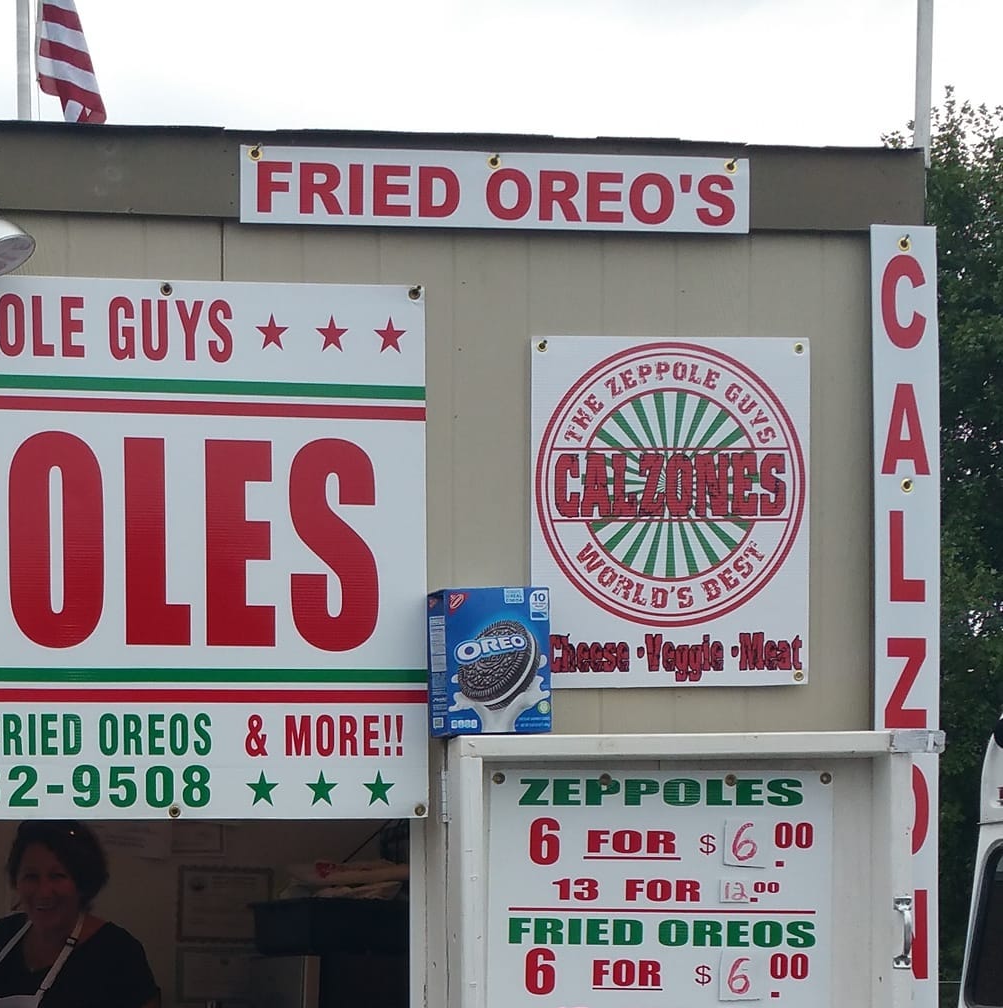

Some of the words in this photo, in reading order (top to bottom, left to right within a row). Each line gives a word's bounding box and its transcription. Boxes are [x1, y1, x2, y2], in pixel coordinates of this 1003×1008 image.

[256, 160, 461, 218] FRIED
[485, 168, 737, 227] OREO'S
[108, 295, 233, 363] GUYS
[564, 393, 605, 443] THE
[603, 361, 722, 400] ZEPPOLE
[724, 382, 777, 445] GUYS
[554, 452, 787, 519] CALZONES
[576, 541, 694, 609] WORLD'S
[700, 539, 766, 603] BEST
[533, 593, 546, 602] 10
[456, 635, 527, 662] OREO
[549, 633, 630, 673] Cheese
[98, 712, 213, 758] OREOS
[245, 714, 269, 757] &
[284, 714, 405, 758] MORE!!
[518, 778, 804, 807] ZEPPOLES
[529, 817, 561, 865] 6
[587, 830, 676, 854] FOR
[552, 878, 599, 901] 13
[625, 879, 701, 902] FOR
[508, 917, 644, 945] FRIED
[658, 919, 816, 947] OREOS
[524, 948, 556, 995] 6
[592, 959, 661, 987] FOR
